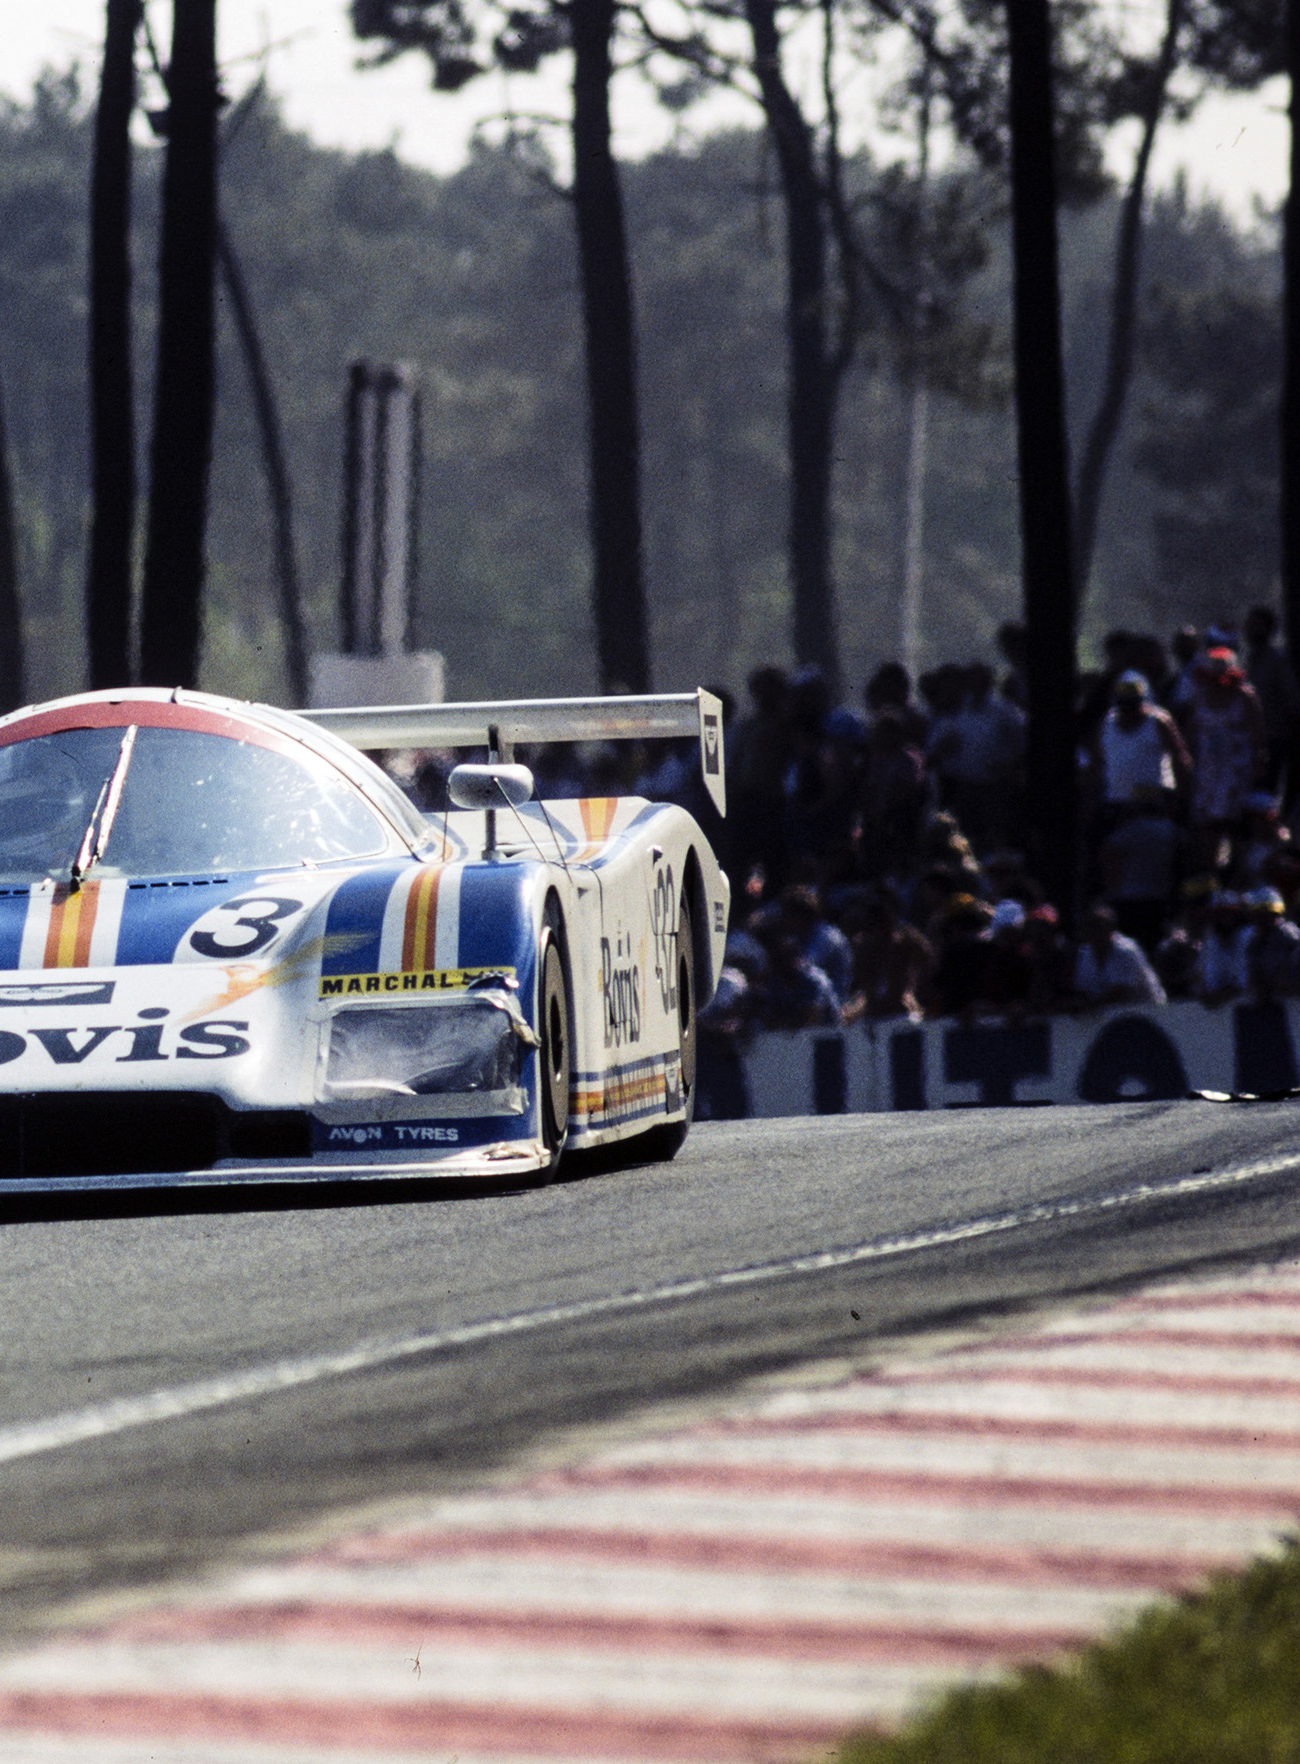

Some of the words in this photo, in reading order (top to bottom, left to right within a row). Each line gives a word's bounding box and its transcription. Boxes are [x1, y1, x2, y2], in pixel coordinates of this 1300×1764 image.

[322, 973, 454, 994] MARCHAL
[329, 1126, 383, 1144] AVON
[394, 1126, 459, 1142] TYRES
